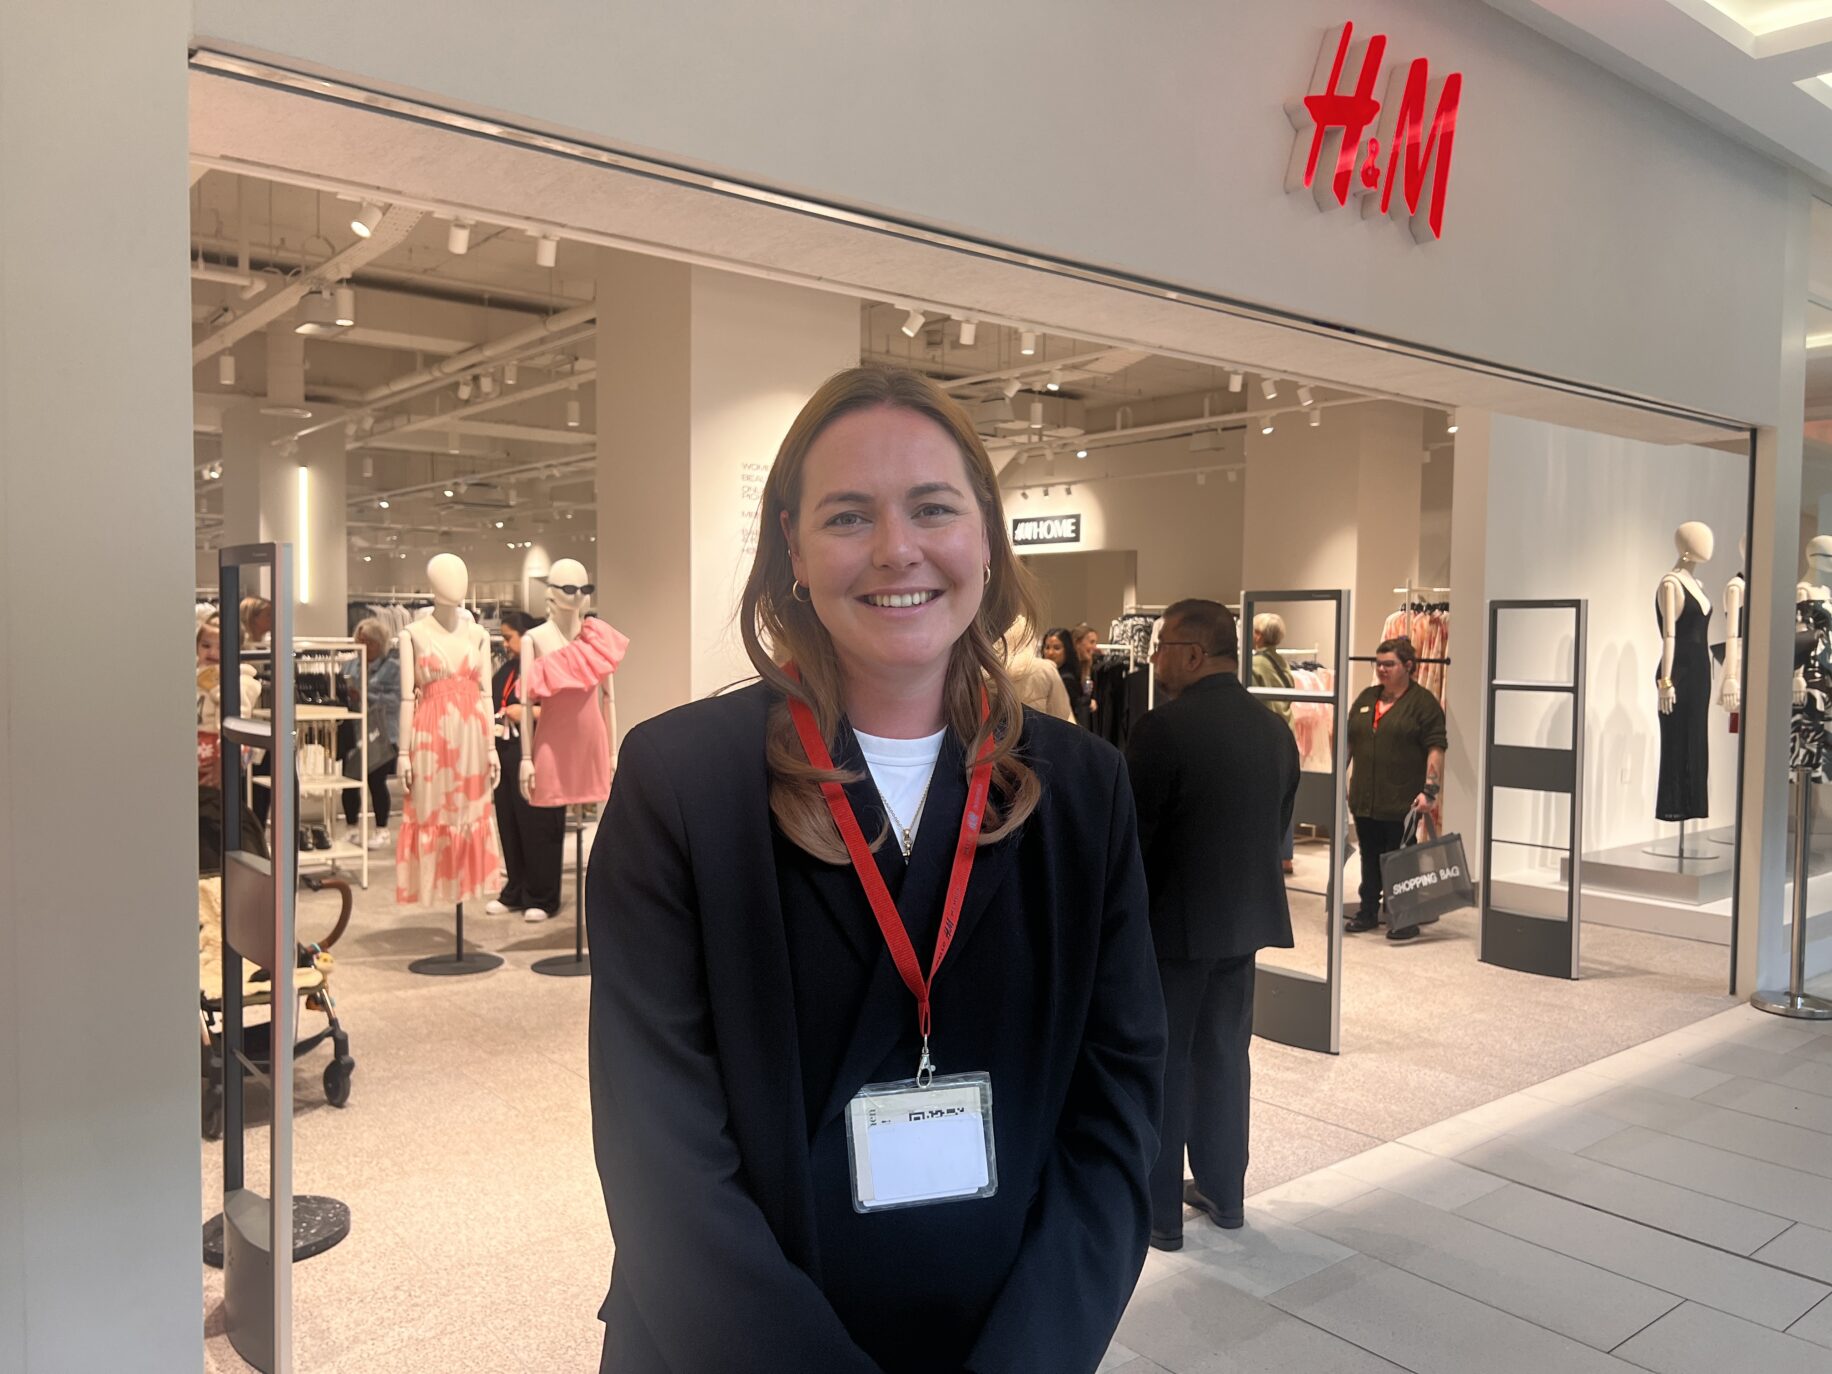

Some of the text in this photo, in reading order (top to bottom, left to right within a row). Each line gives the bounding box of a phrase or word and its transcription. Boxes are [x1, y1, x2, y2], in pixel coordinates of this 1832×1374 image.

[1303, 20, 1462, 240] H&M
[1033, 518, 1076, 539] HOME
[1392, 865, 1460, 895] SHOPPING BAG
